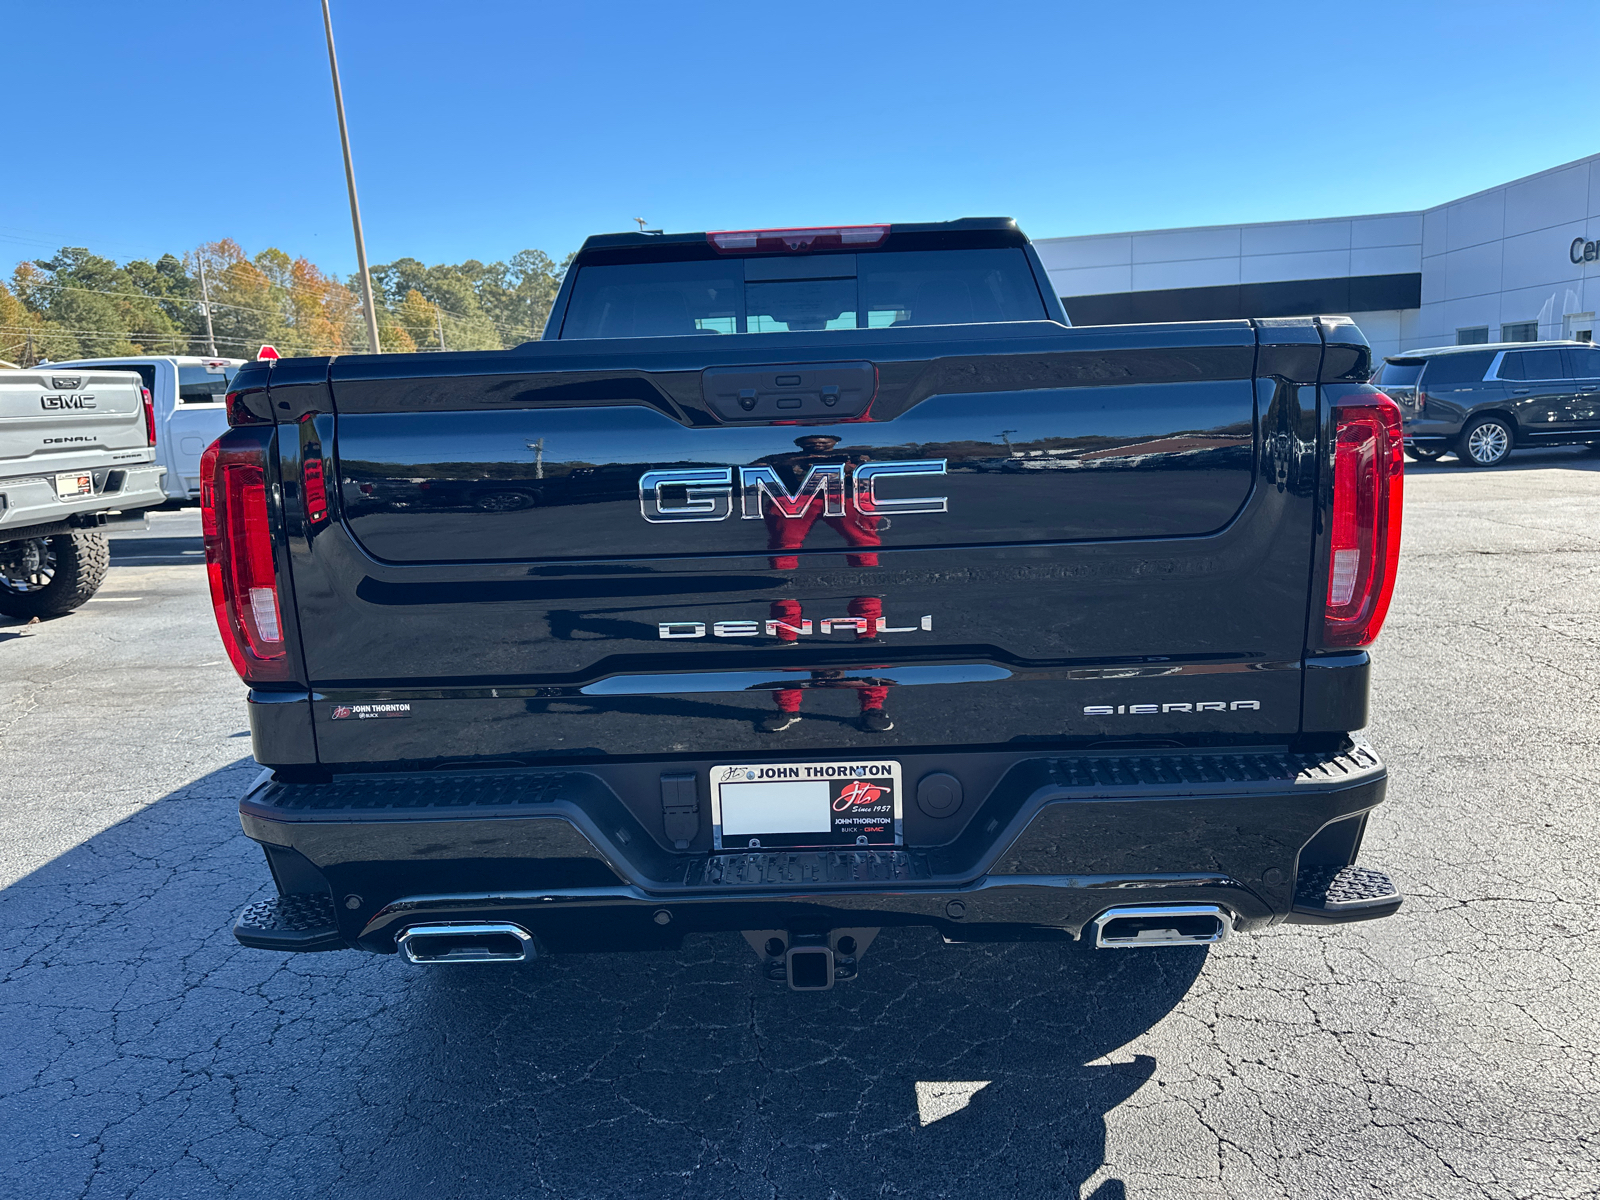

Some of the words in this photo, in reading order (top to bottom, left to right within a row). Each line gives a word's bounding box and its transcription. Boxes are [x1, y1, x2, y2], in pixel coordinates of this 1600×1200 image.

[41, 394, 97, 410] GMC
[43, 436, 97, 444] DENALI
[639, 458, 948, 524] GMC
[659, 615, 932, 638] DENALI
[372, 703, 411, 712] THORNTON
[1083, 700, 1260, 715] SIERRA
[757, 768, 800, 779] JOHN
[804, 765, 892, 777] THORNTON
[851, 805, 872, 813] Since
